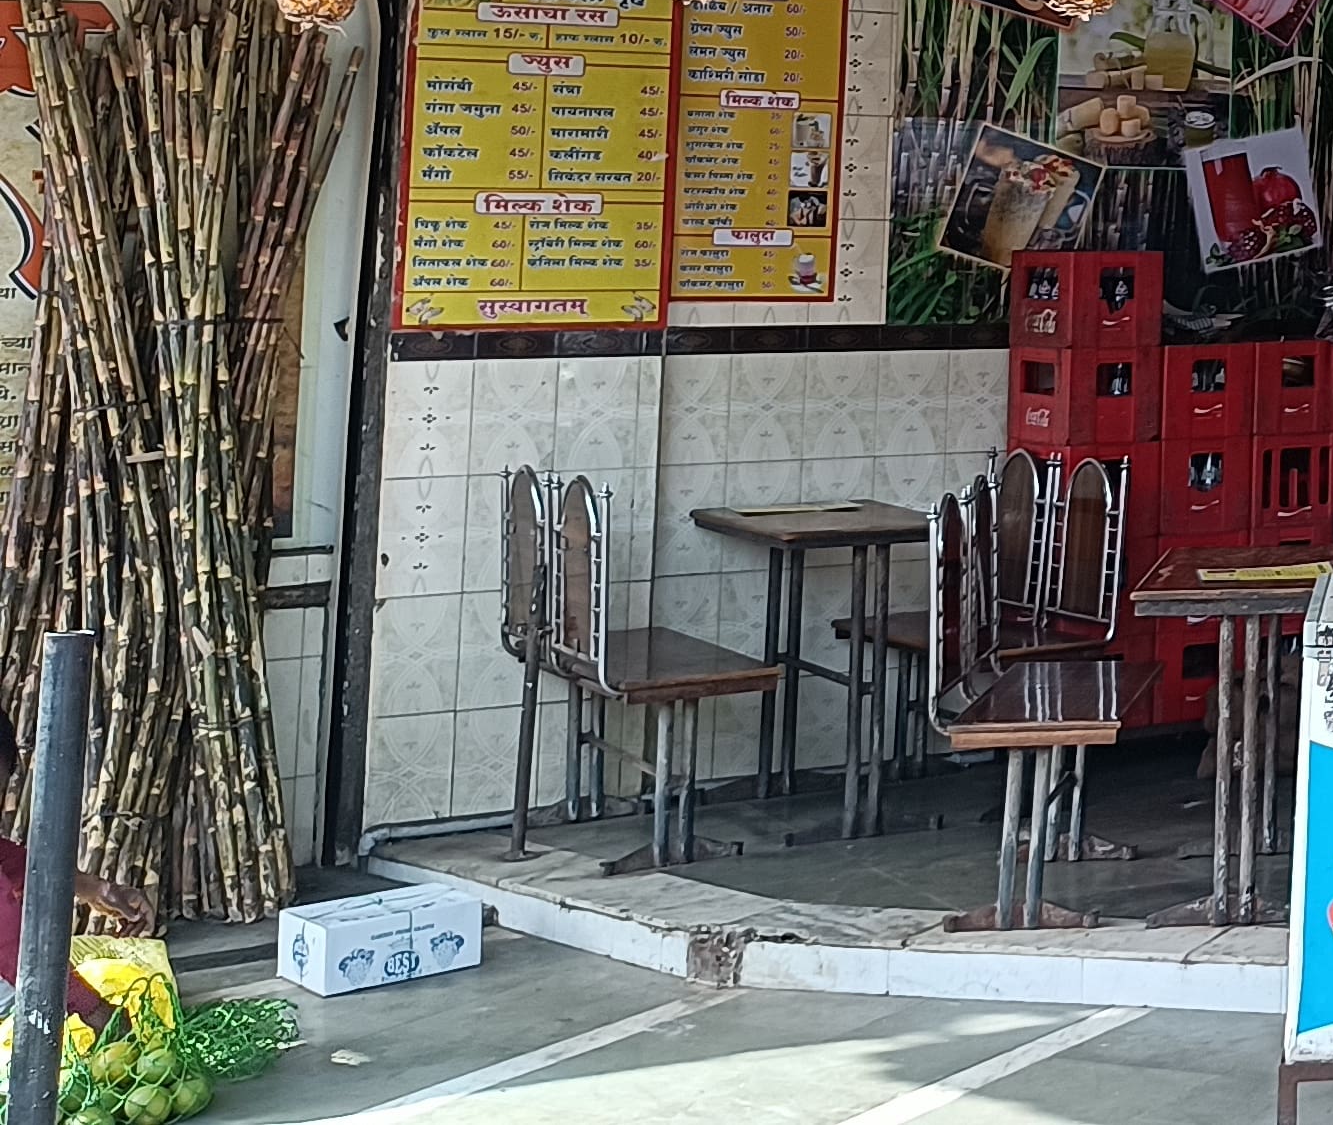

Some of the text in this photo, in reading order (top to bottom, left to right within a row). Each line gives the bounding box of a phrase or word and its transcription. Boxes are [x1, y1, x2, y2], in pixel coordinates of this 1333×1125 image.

[490, 5, 607, 22] ऊसाचा रस
[787, 4, 806, 13] 60/-
[494, 28, 525, 39] 15/-
[786, 27, 805, 36] 50/-
[620, 34, 649, 44] 10/-
[785, 50, 804, 60] 20/-
[521, 55, 573, 73] ज्युस
[784, 72, 803, 82] 20/-
[512, 82, 537, 91] 45/-
[641, 86, 664, 96] 45/-
[725, 91, 763, 106] मिल्क
[512, 105, 536, 114] 45/-
[640, 108, 663, 117] 45/-
[511, 126, 535, 136] 50/-
[638, 129, 662, 139] 45/-
[510, 148, 534, 158] 45/-
[509, 170, 533, 179] 55/-
[637, 172, 660, 182] 20/-
[484, 194, 595, 212] मिल्क शेक
[731, 230, 775, 245] फालुदा
[478, 299, 588, 319] सुस्वागतम्
